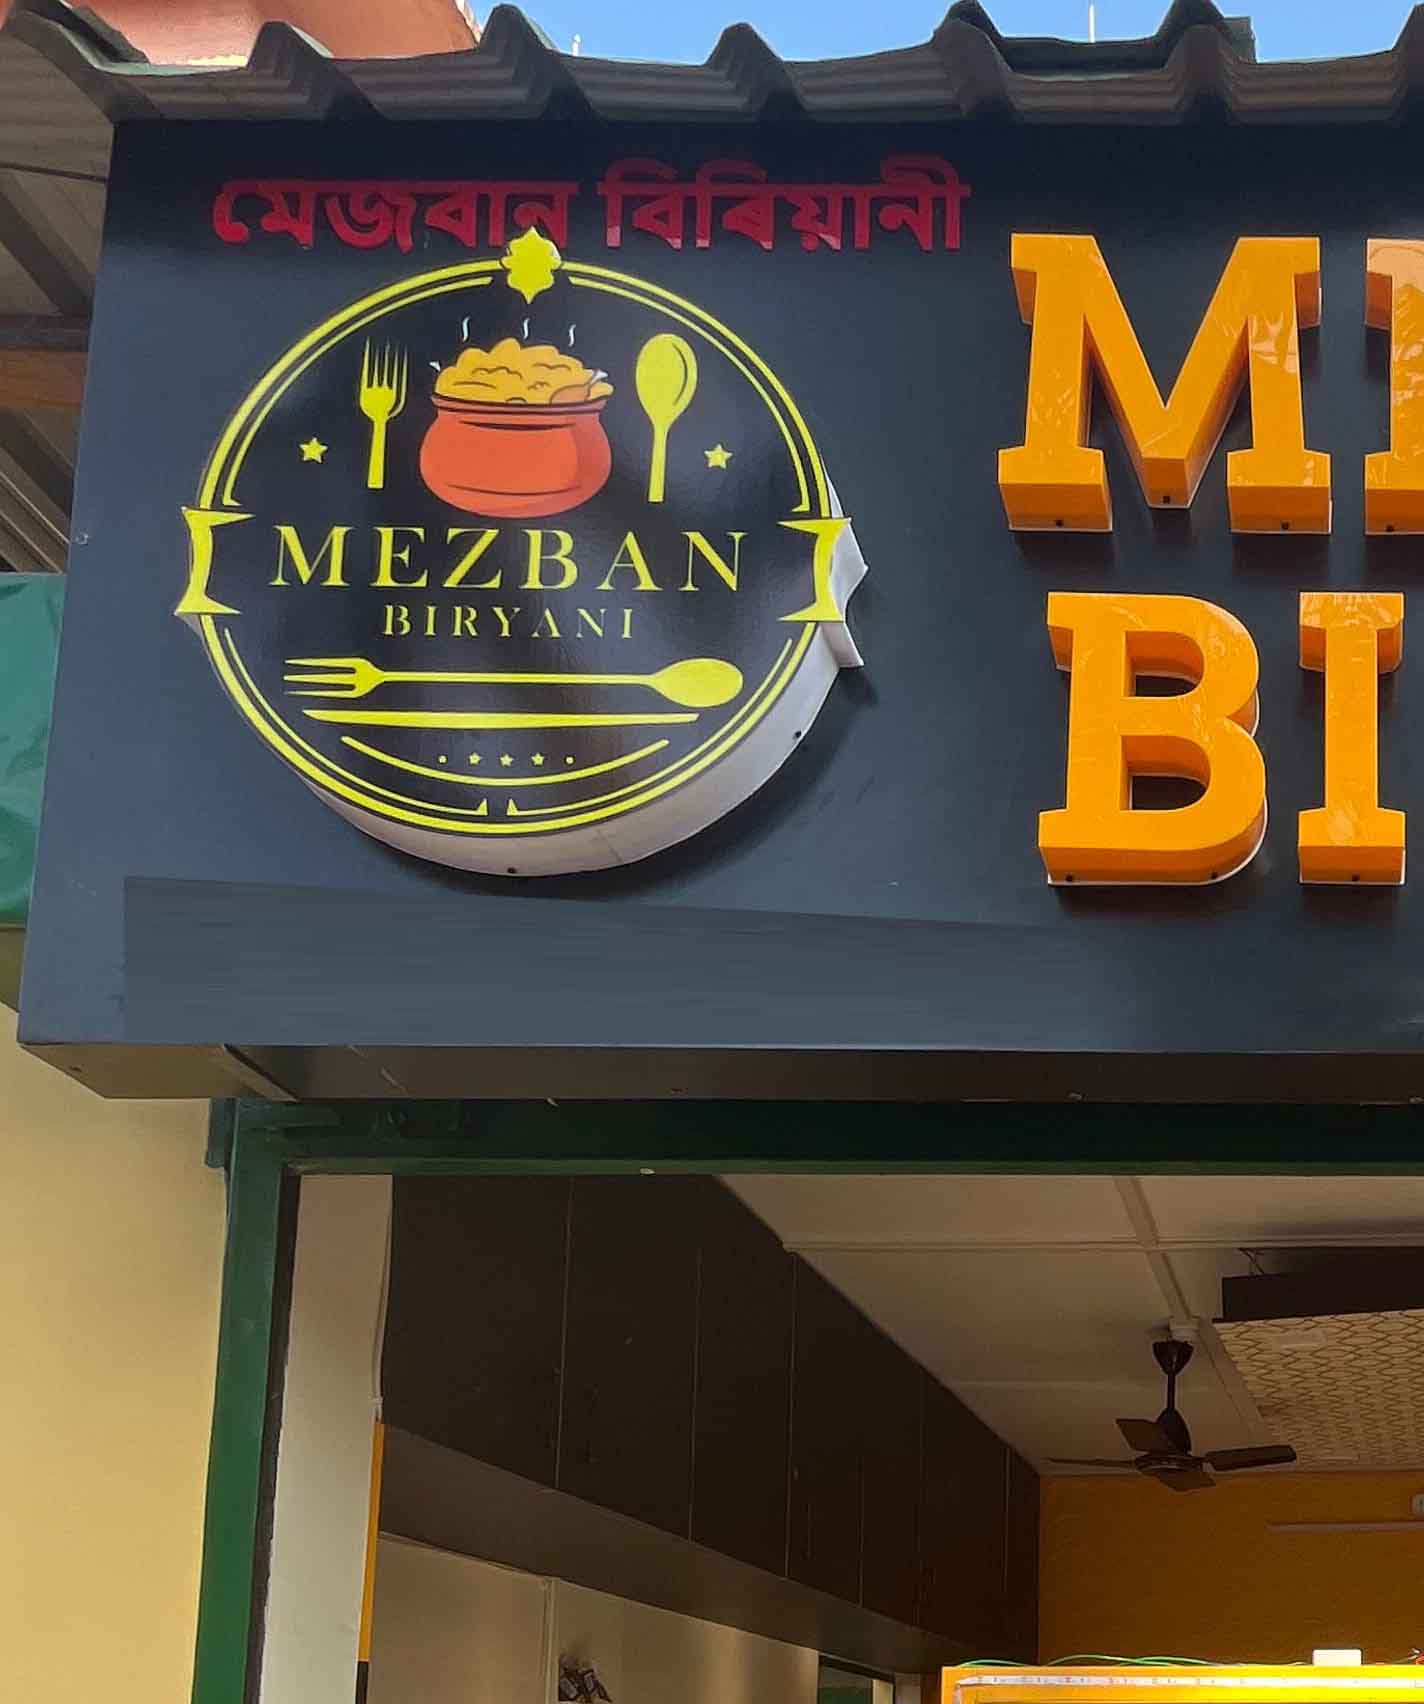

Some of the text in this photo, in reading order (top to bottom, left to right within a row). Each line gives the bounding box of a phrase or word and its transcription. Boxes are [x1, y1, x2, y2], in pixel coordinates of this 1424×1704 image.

[212, 178, 578, 251] মেজবান
[269, 525, 747, 591] MEZBAN
[382, 604, 633, 639] BIRYANI
